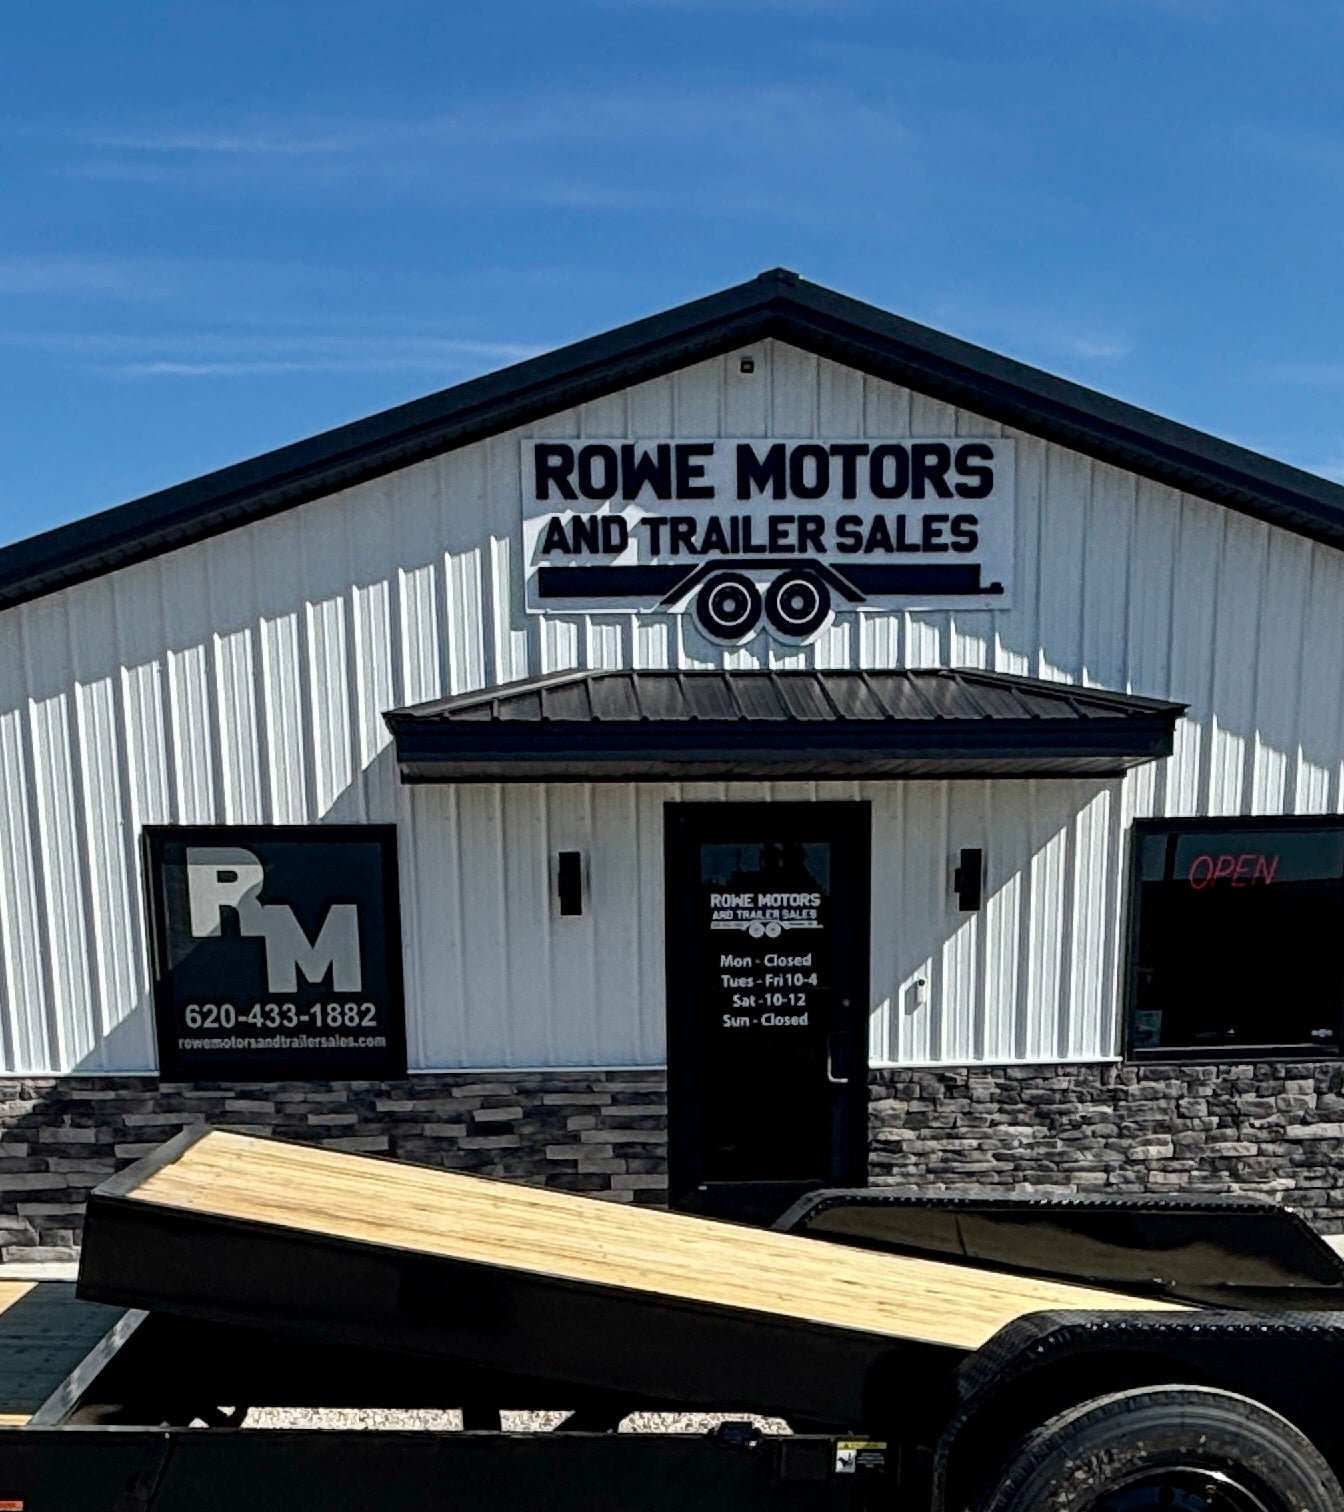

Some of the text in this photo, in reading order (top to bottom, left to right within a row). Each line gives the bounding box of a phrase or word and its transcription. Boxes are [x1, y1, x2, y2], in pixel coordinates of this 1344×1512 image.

[534, 442, 995, 501] ROWE MOTORS
[542, 514, 980, 555] AND TRAILER SALES
[1189, 854, 1279, 889] OPEN
[710, 892, 822, 908] ROWE MOTORS
[712, 908, 818, 920] AND TRAILER SALES
[720, 954, 752, 968] Mon
[764, 953, 812, 967] Closed
[720, 974, 754, 988] Tues
[765, 973, 784, 987] Fri
[786, 972, 818, 987] 10-4
[732, 992, 756, 1008] Sat
[184, 1002, 377, 1029] 620-433-1882
[722, 1014, 750, 1027] Sun
[761, 1012, 809, 1026] Closed
[178, 1033, 387, 1050] rowemotorsandtrailersales.com
